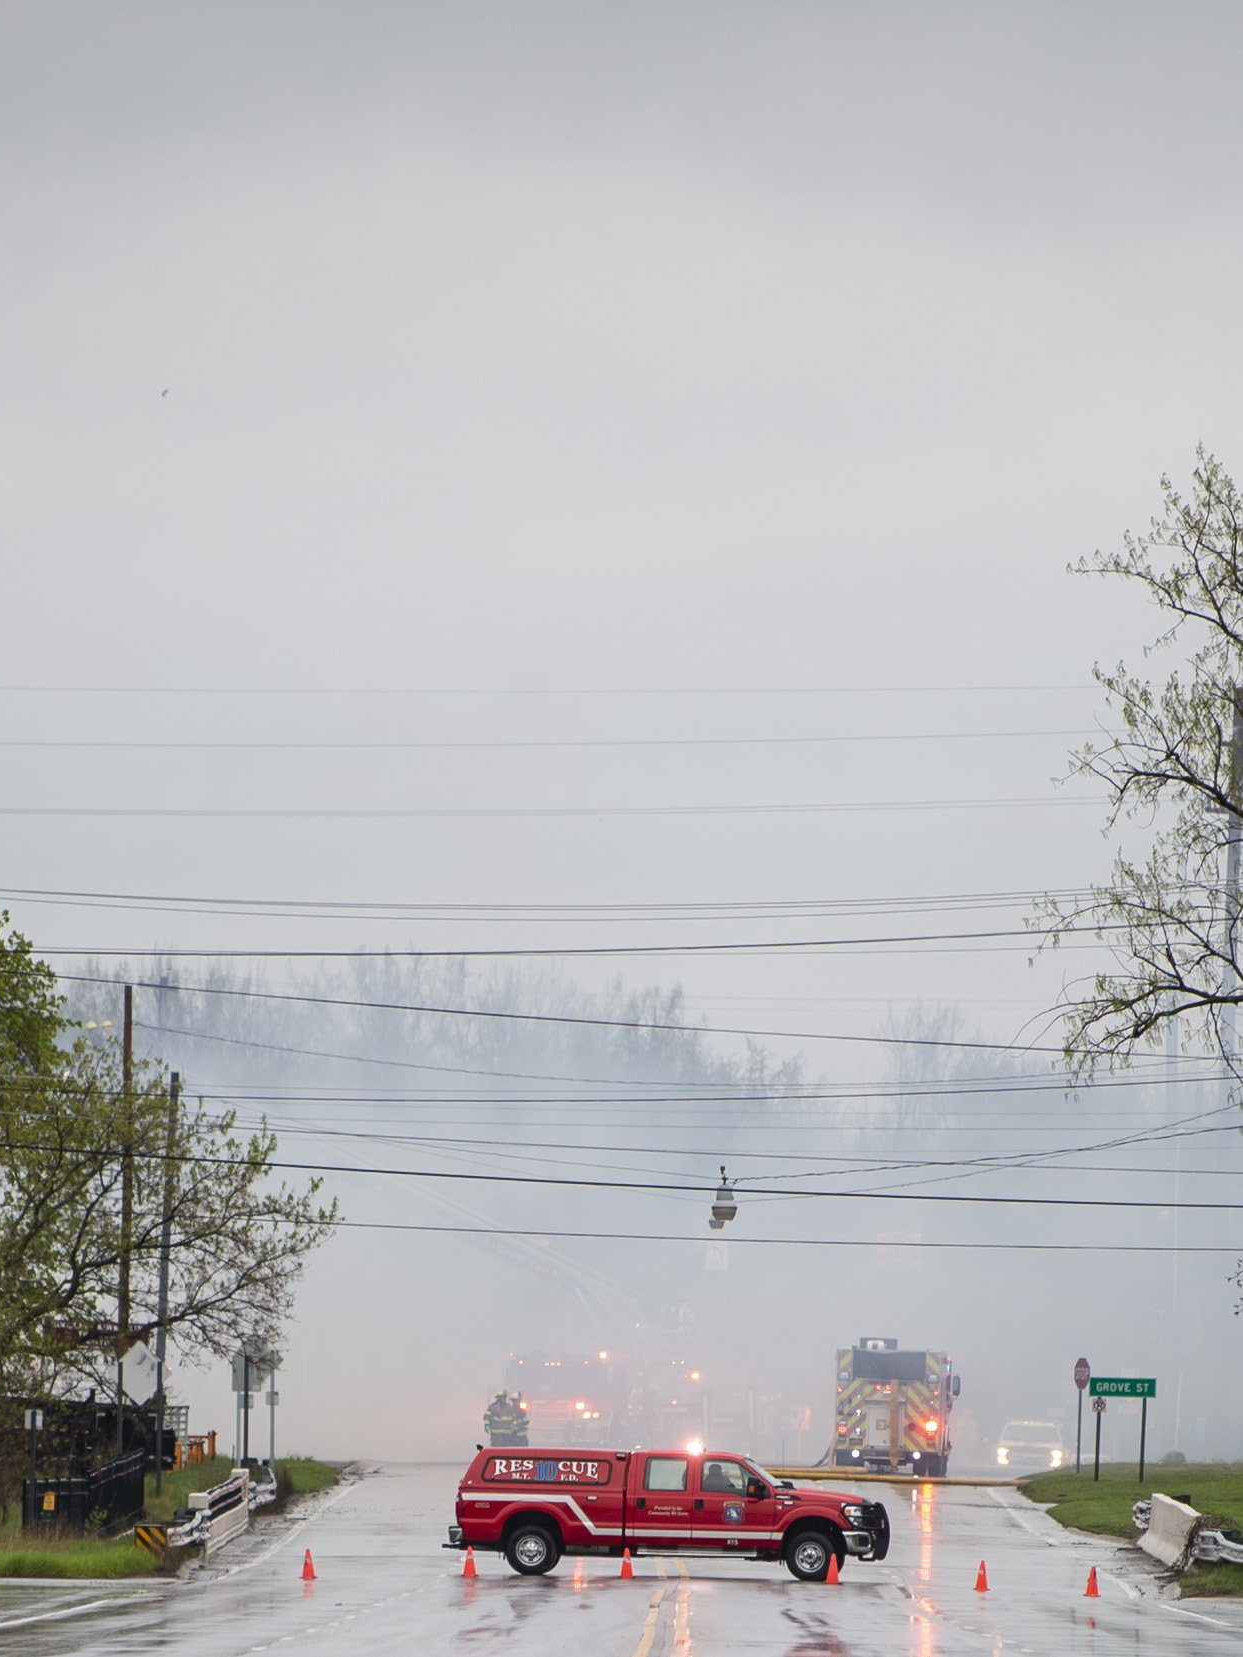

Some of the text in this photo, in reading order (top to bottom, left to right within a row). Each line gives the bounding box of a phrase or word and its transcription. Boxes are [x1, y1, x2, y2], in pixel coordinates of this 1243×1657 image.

[1075, 1367, 1090, 1380] STOP
[1096, 1382, 1150, 1393] GROVE ST
[534, 1460, 557, 1481] 10
